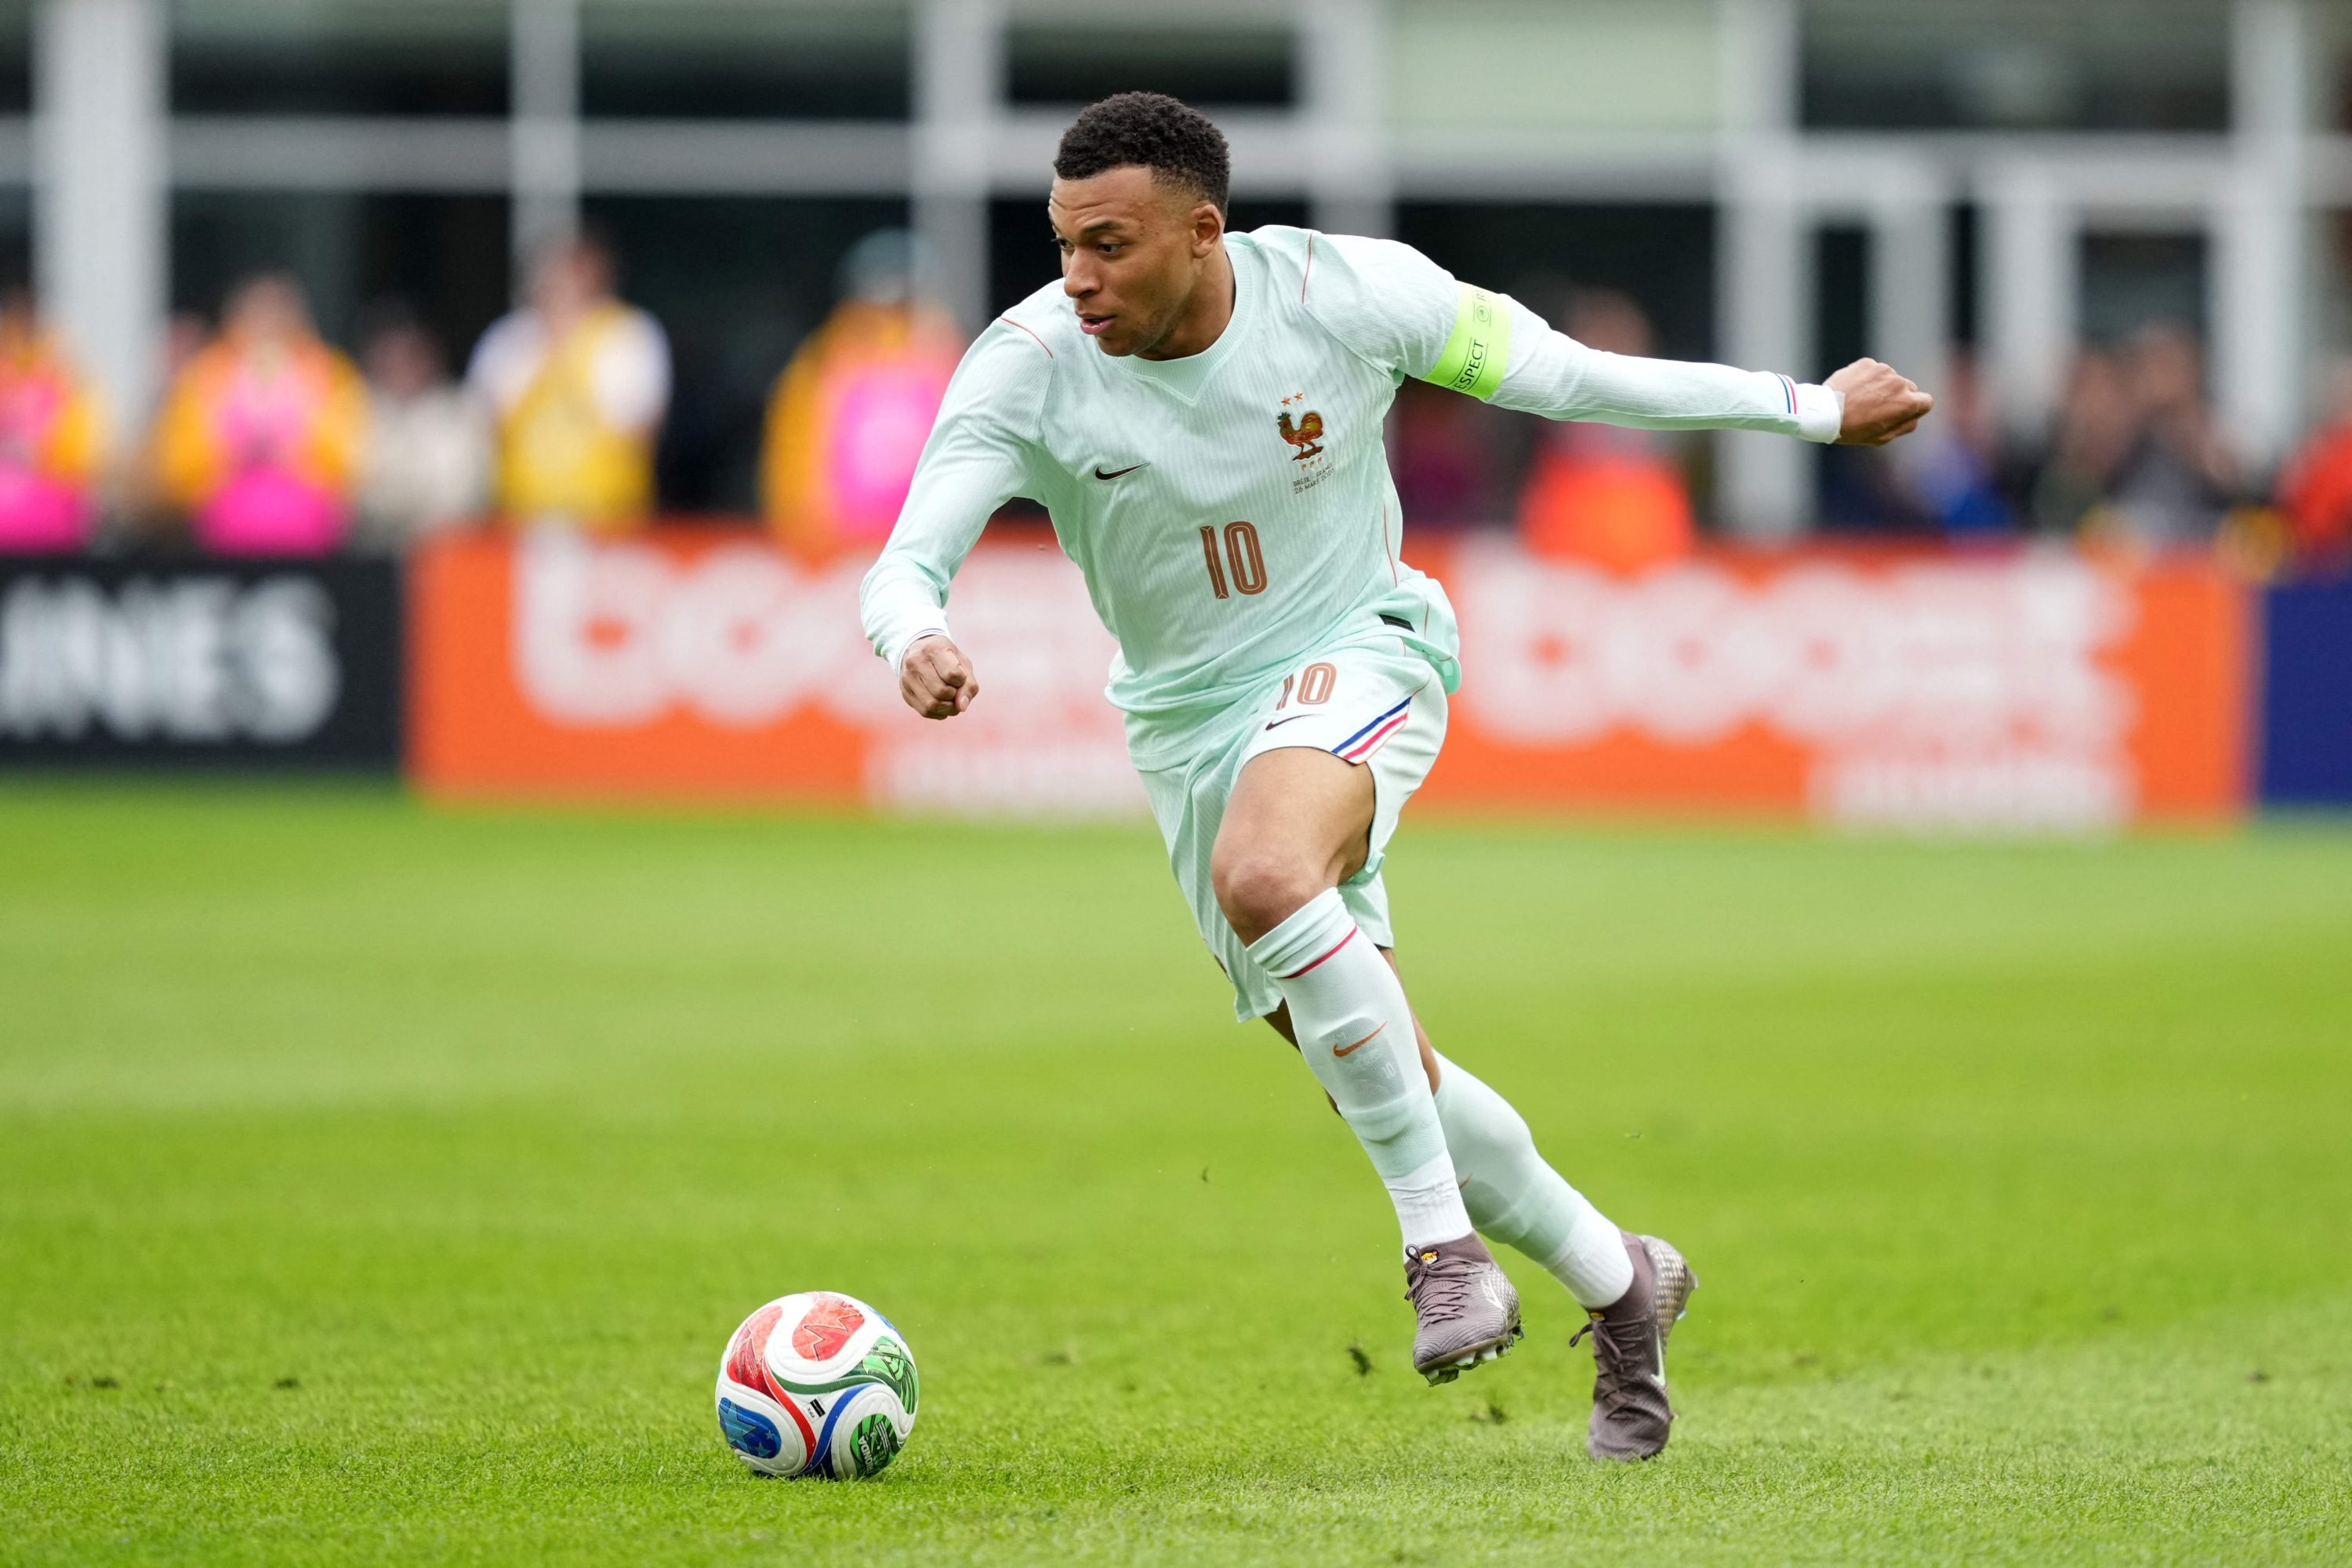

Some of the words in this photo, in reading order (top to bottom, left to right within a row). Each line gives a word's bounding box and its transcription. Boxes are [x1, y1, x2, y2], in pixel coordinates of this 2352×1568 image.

[1305, 478, 1319, 490] MARS
[1316, 462, 1333, 477] FRANCE
[1200, 521, 1267, 599] 10
[1276, 662, 1337, 711] 10
